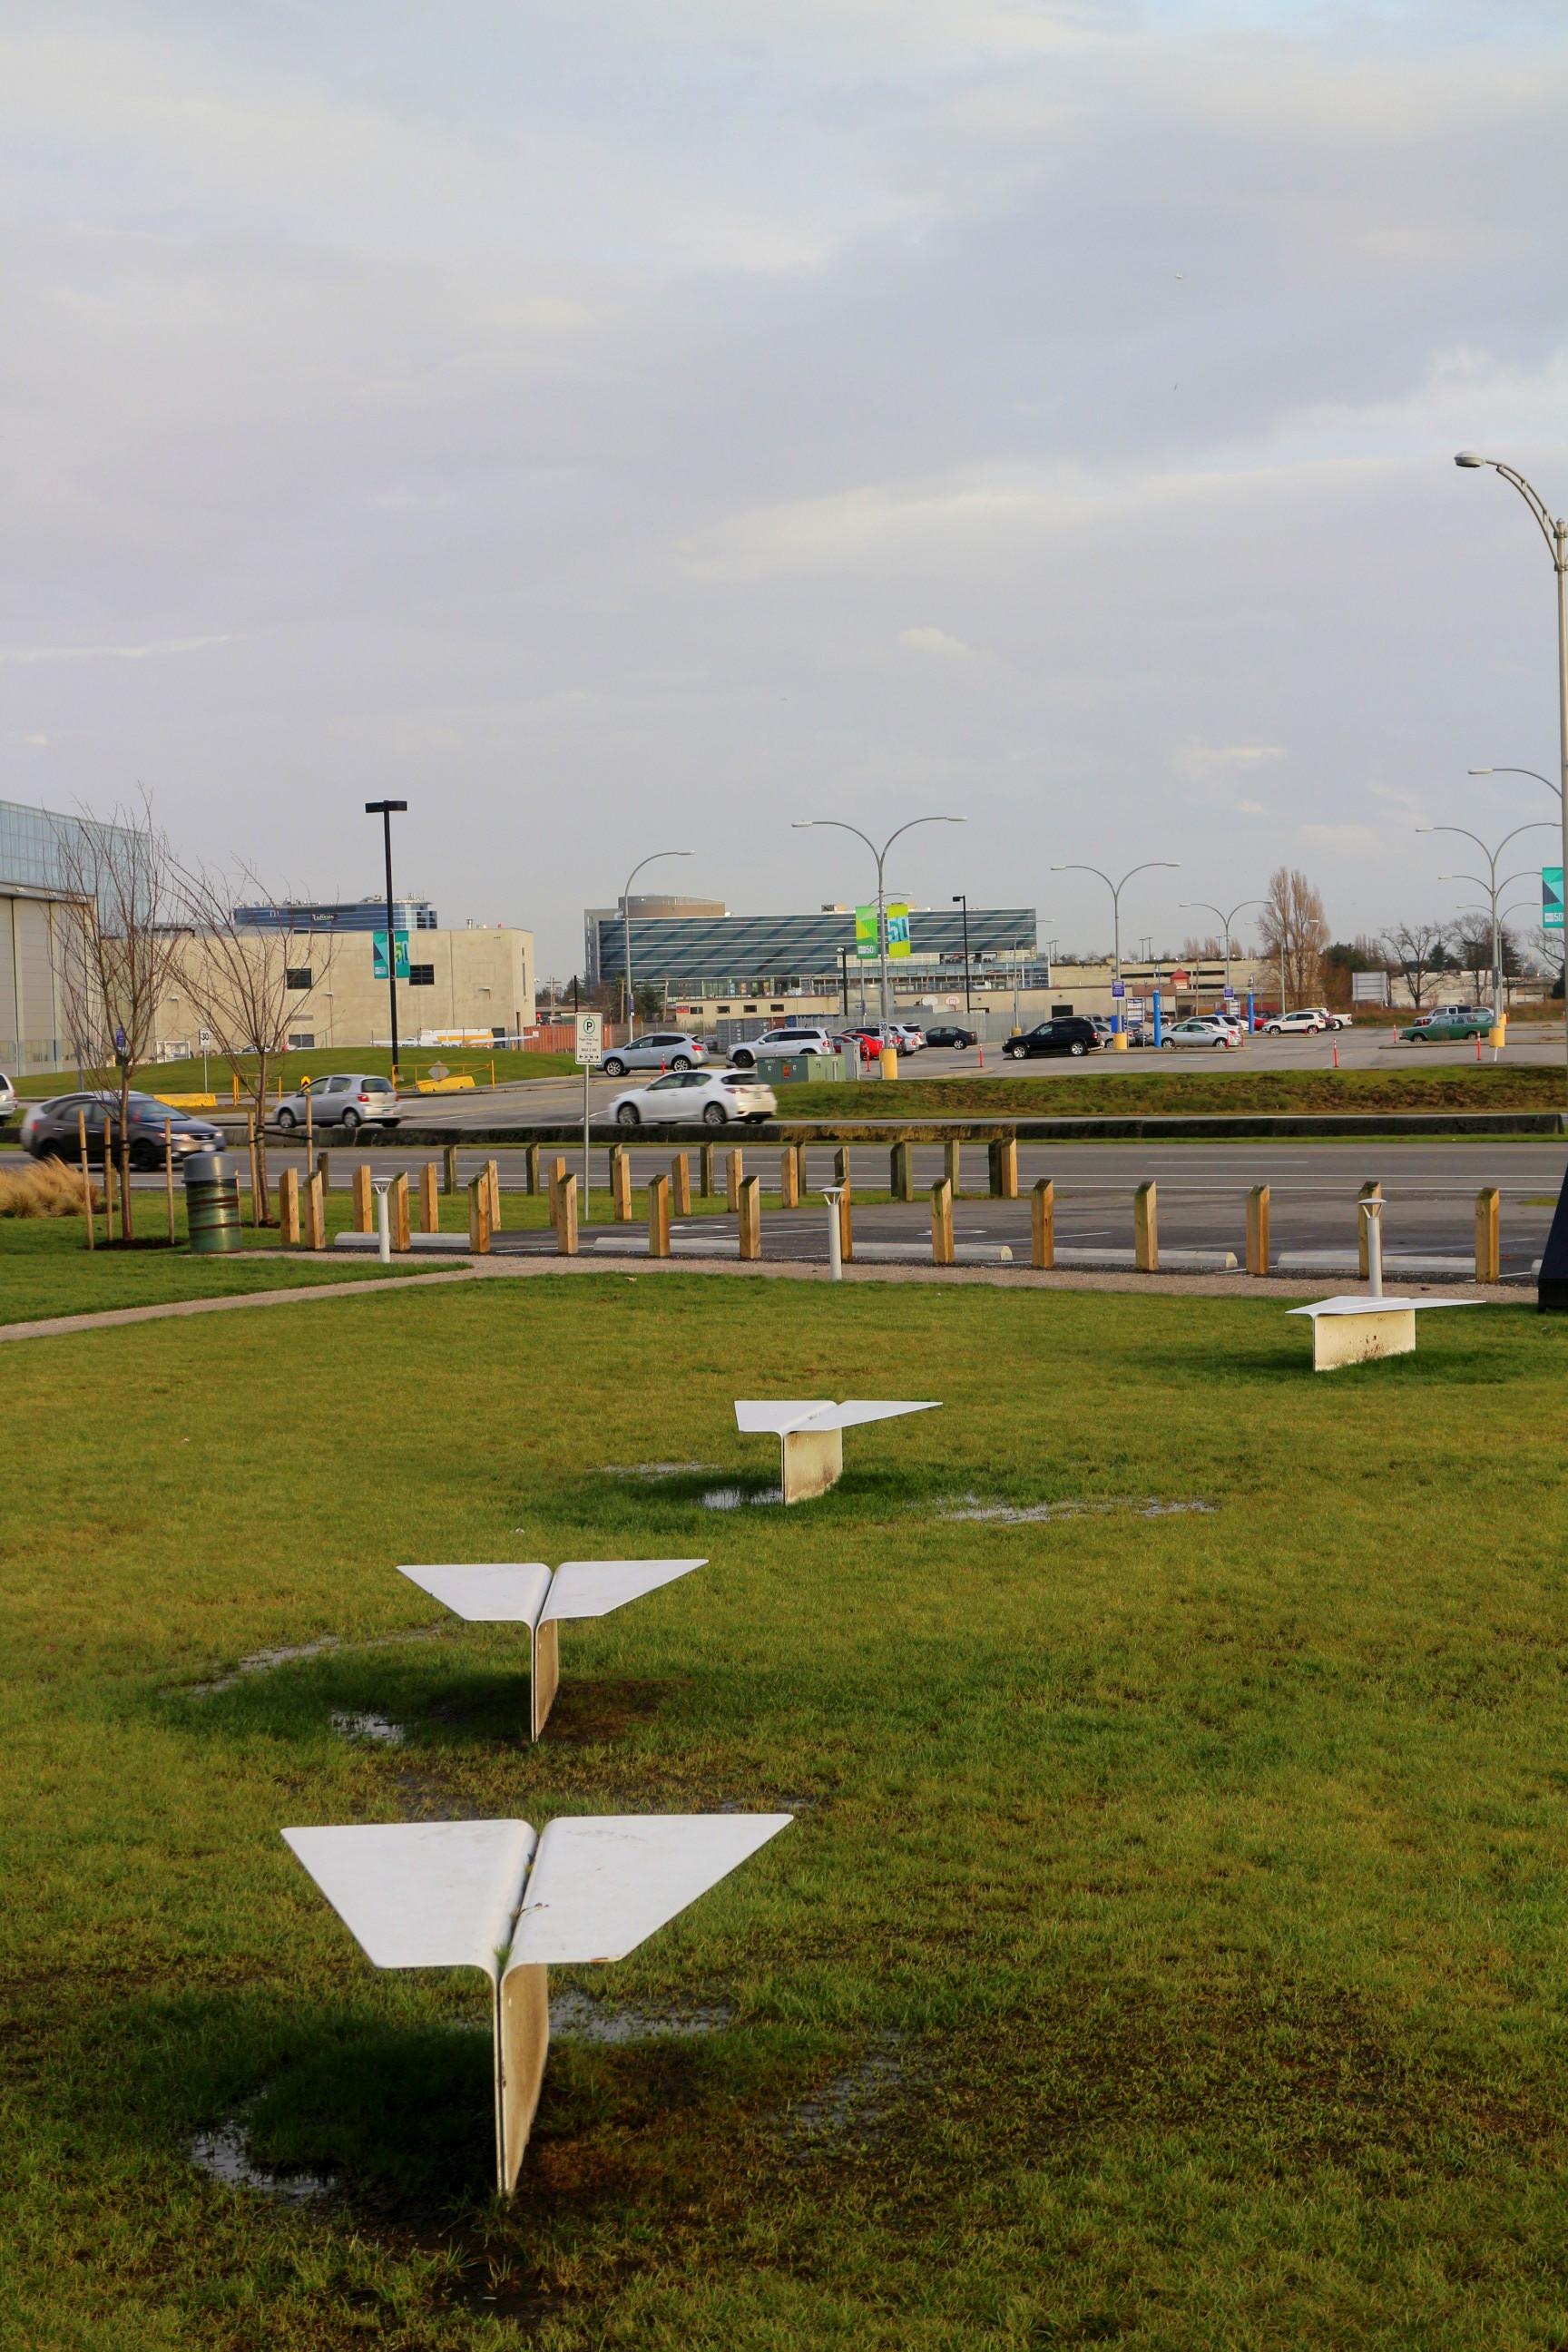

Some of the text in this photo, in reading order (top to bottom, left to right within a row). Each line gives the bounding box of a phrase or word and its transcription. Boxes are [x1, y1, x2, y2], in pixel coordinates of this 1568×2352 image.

[1553, 913, 1563, 922] 50
[887, 916, 910, 944] 50
[395, 940, 409, 965] 50
[866, 946, 874, 954] 50
[586, 1022, 593, 1031] P
[880, 1023, 887, 1031] 30
[201, 1032, 209, 1040] 30
